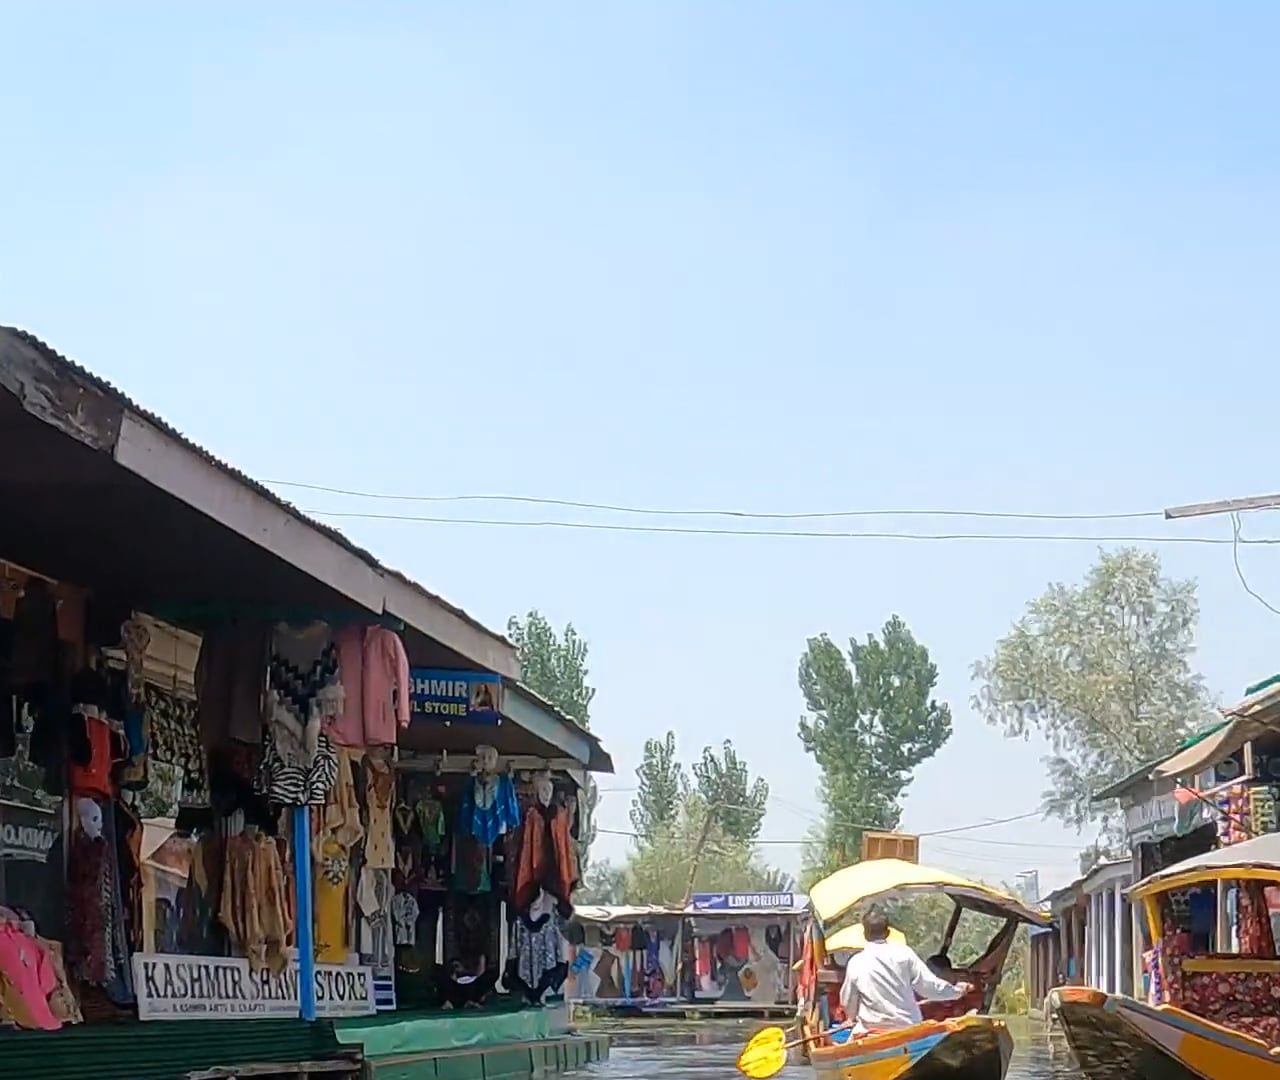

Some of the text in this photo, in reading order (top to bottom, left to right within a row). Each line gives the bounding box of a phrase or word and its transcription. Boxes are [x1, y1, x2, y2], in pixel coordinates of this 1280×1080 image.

[425, 701, 467, 716] STORE
[143, 962, 247, 1001] KASHMIR
[315, 970, 369, 1001] STORE
